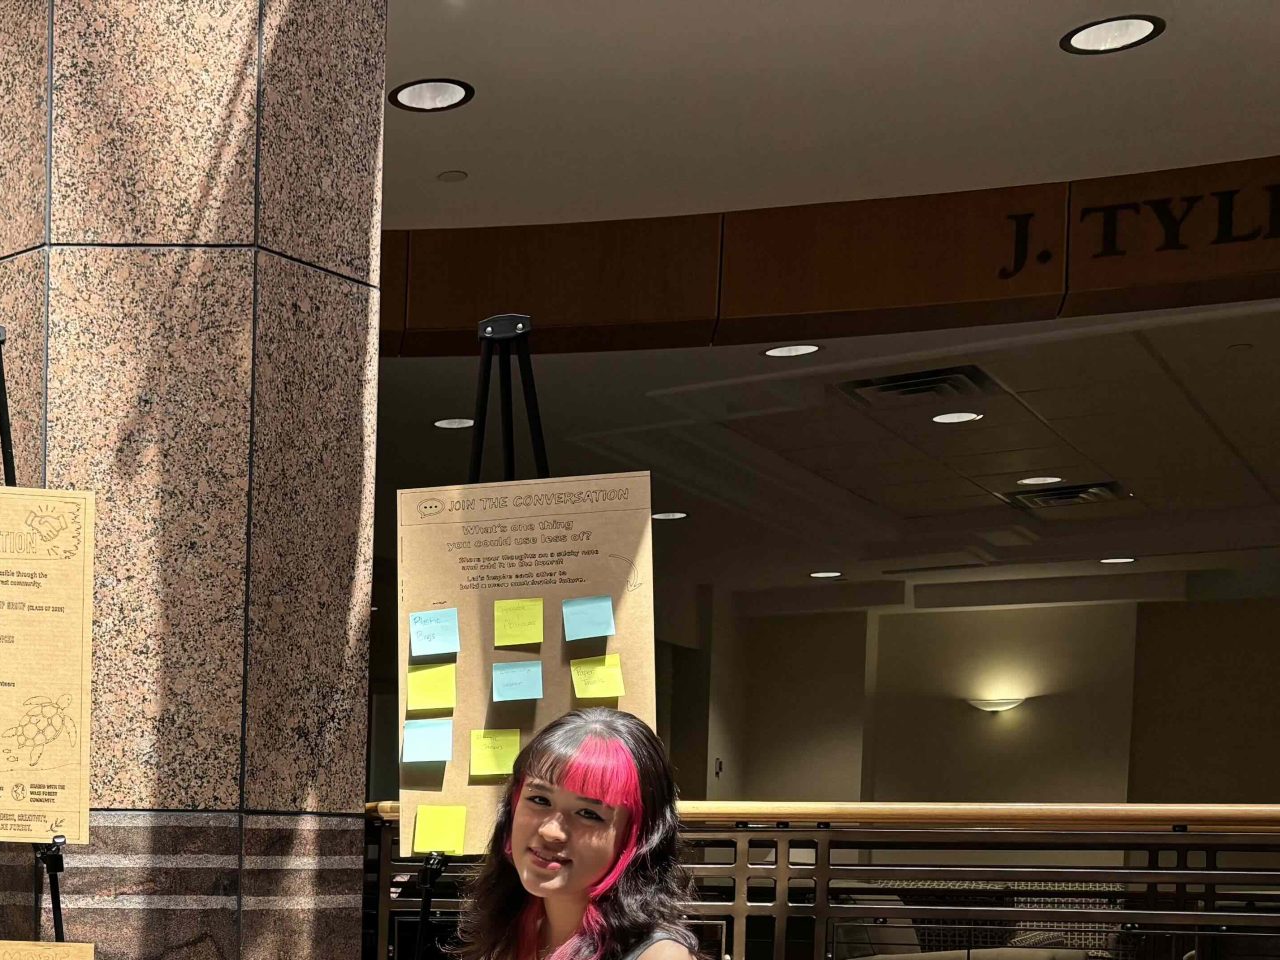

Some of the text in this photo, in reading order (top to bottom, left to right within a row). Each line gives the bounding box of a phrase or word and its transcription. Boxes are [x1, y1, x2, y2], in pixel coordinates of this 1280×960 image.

[998, 213, 1053, 279] J.
[448, 488, 629, 512] JOIN THE CONVERSATION
[462, 519, 574, 536] What's one thing
[448, 531, 592, 552] you could use less of?
[10, 579, 42, 589] community.
[16, 570, 37, 579] through
